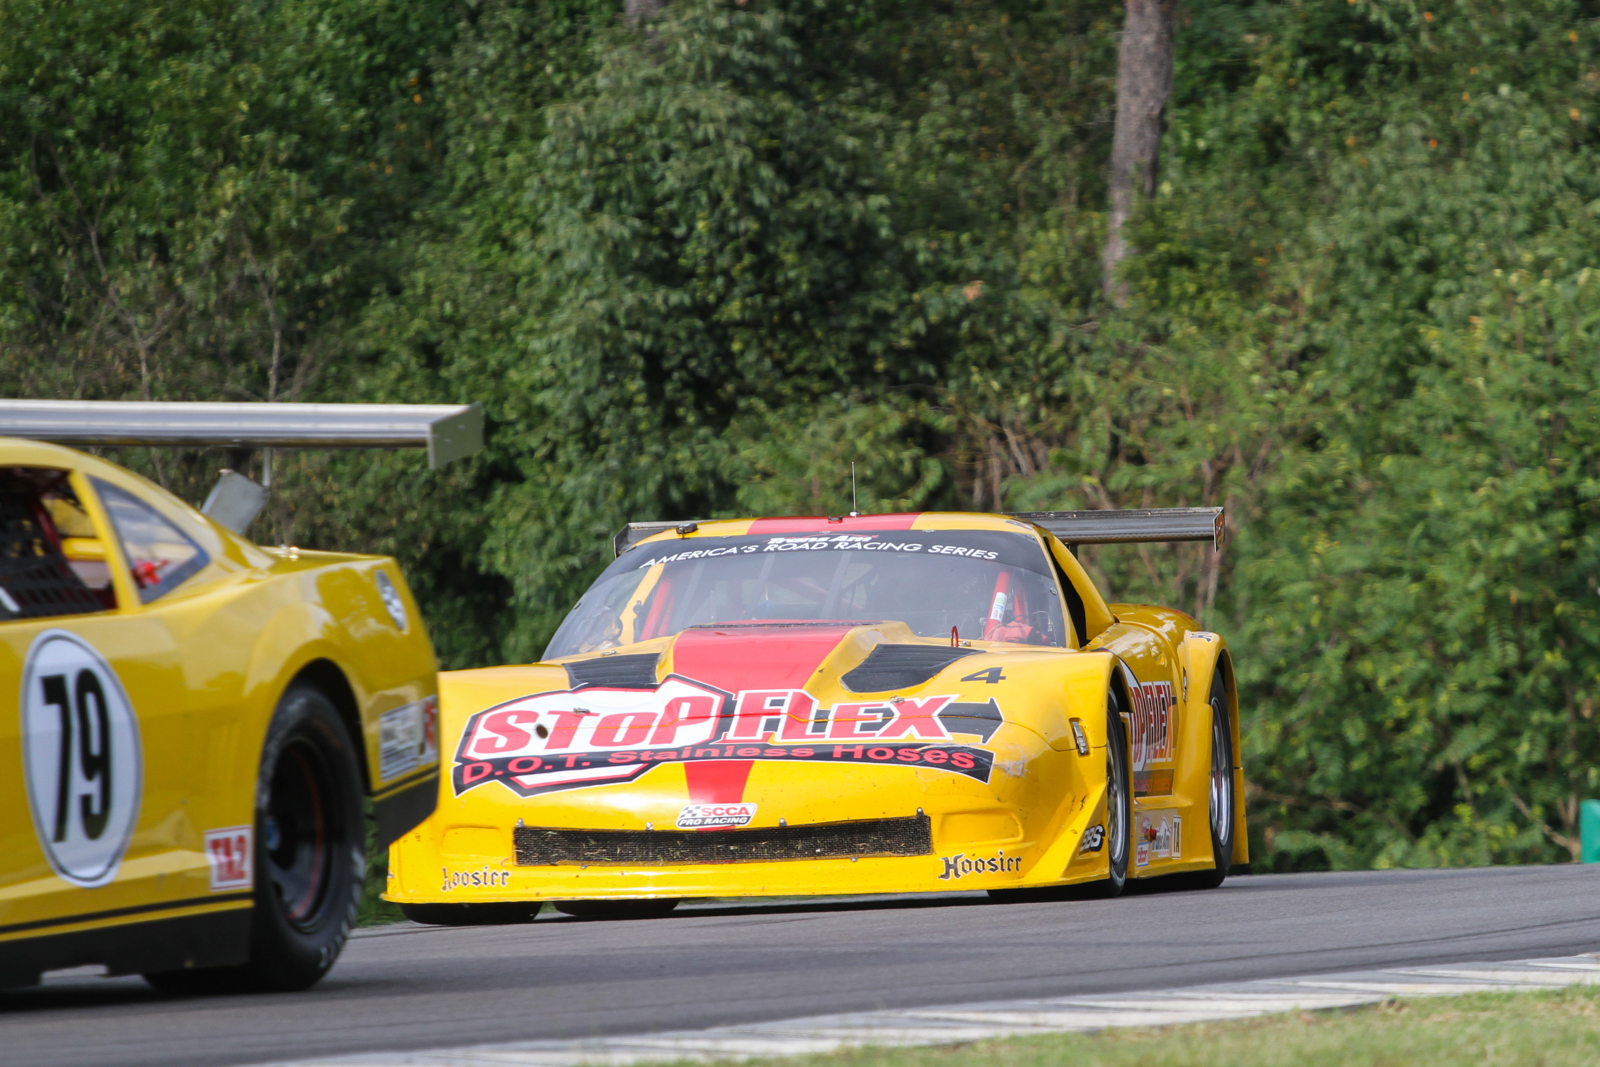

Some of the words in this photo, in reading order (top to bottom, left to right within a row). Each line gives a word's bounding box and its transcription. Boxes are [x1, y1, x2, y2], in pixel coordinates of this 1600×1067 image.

[639, 544, 759, 569] AMERICA'S
[763, 542, 829, 552] ROAD
[833, 541, 923, 552] RACING
[927, 544, 999, 560] SERIES
[960, 667, 1006, 684] 4
[40, 667, 111, 843] 79
[607, 744, 816, 765] Stainless
[832, 744, 976, 769] Hoses
[679, 818, 703, 826] PRO
[703, 816, 749, 826] RACING
[701, 806, 751, 817] SCCA
[209, 835, 247, 882] TA2
[938, 850, 1022, 880] Hoosier
